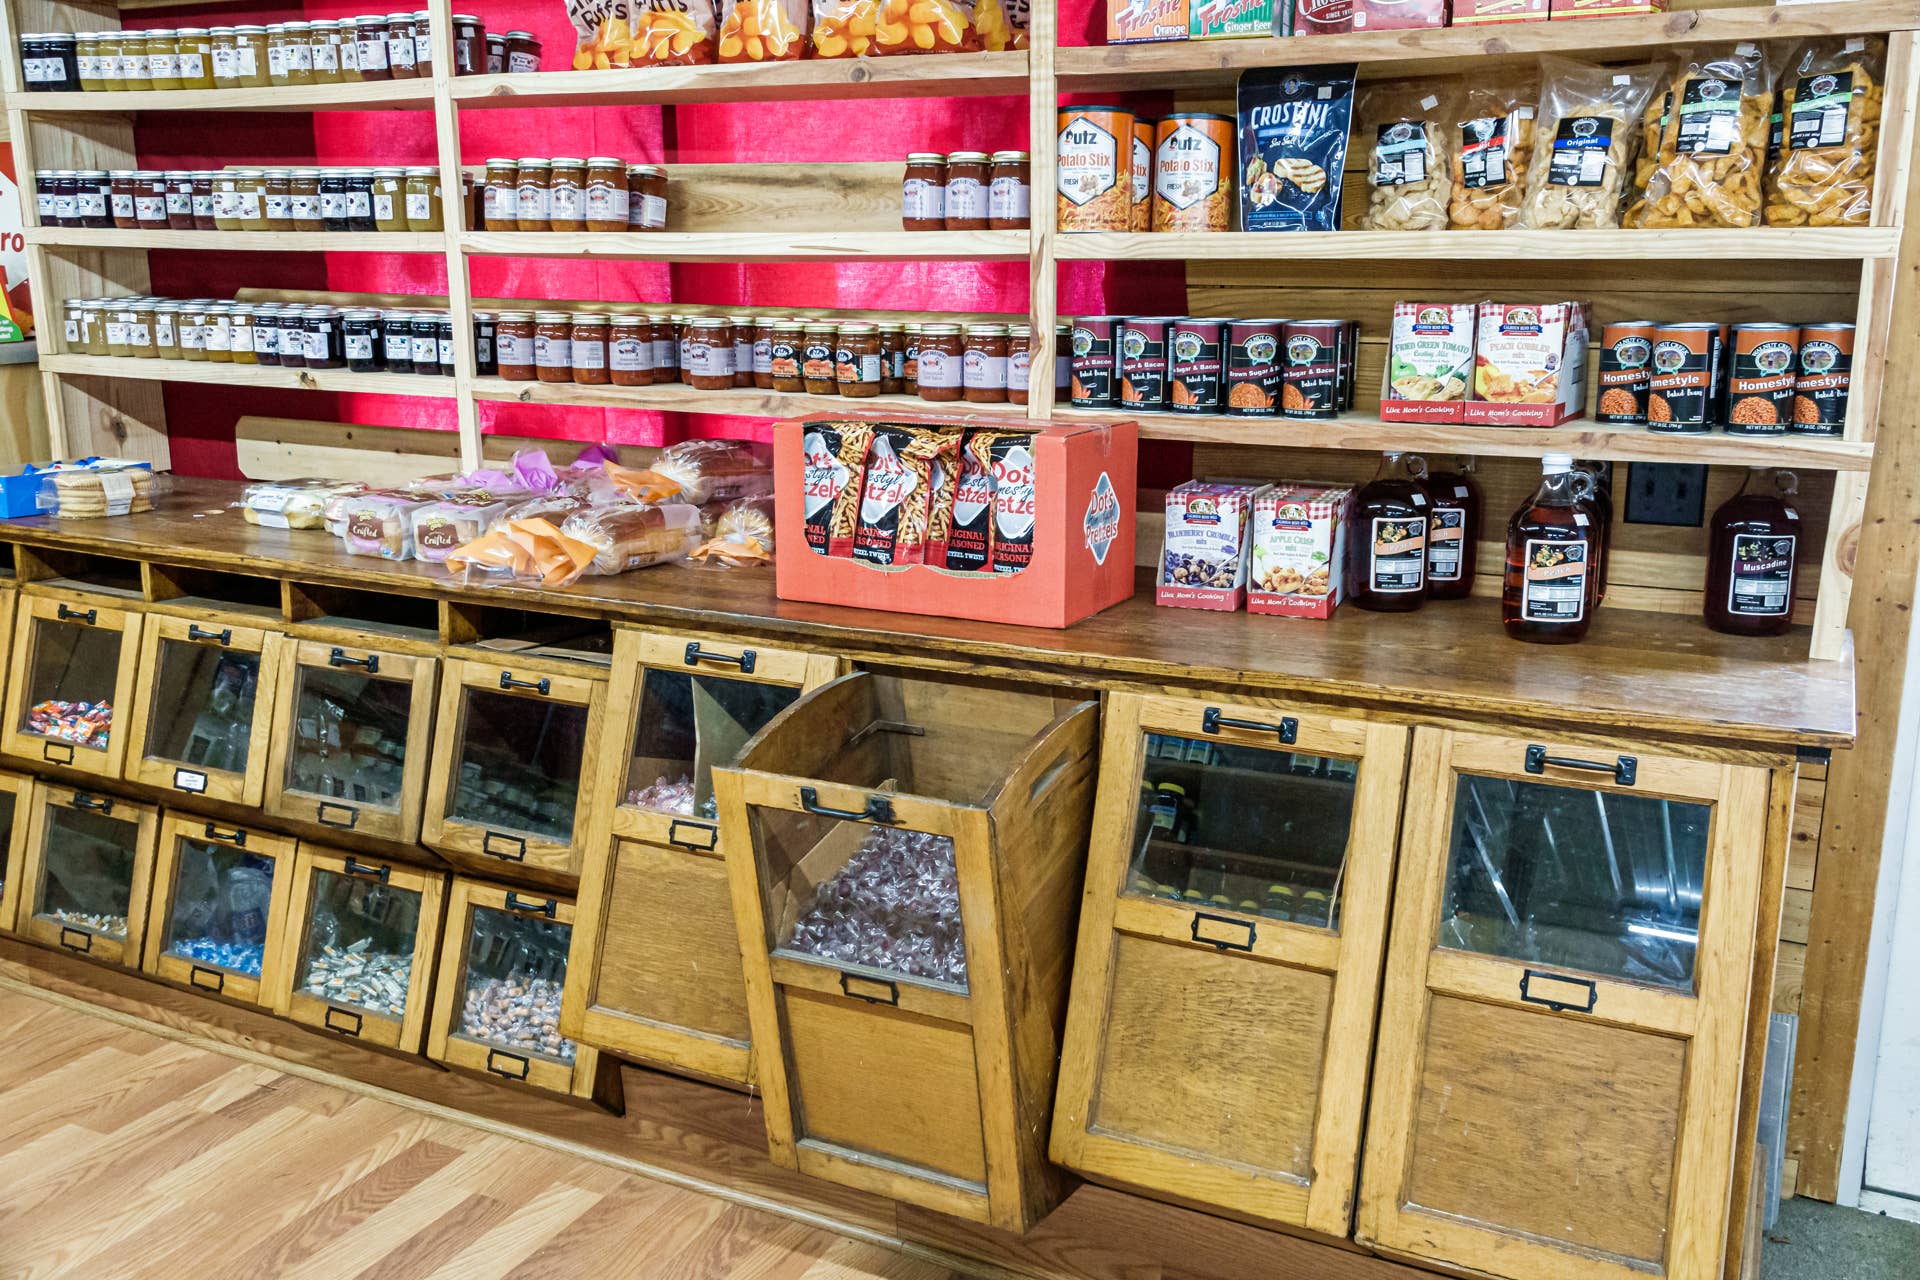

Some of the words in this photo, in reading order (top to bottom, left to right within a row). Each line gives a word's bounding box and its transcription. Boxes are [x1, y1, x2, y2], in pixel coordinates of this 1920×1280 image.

[1153, 24, 1187, 36] Orange
[1224, 22, 1251, 33] Ginger
[1254, 20, 1273, 31] Beer
[1251, 100, 1330, 130] CROSTINI
[1074, 131, 1098, 145] utz
[1178, 136, 1202, 151] utz
[1566, 138, 1599, 147] Original
[1089, 153, 1111, 166] Stix
[1160, 160, 1190, 173] Potato
[1192, 159, 1213, 172] Stix
[1395, 342, 1416, 352] FRIED
[1417, 341, 1440, 349] GREEN
[1442, 341, 1470, 354] TOMATO
[1489, 342, 1515, 351] PEACH
[1516, 341, 1551, 353] COBBLER
[1248, 368, 1269, 376] Sugar
[1604, 370, 1651, 382] Homesty
[1650, 374, 1700, 387] omestyle
[1797, 375, 1849, 388] omestyle
[1402, 406, 1423, 414] Mom's
[1425, 406, 1455, 415] Cooking
[1488, 409, 1510, 417] Mom's
[1512, 408, 1544, 418] Cooking
[1090, 488, 1114, 515] Dot's
[353, 525, 377, 538] Crafted
[1085, 521, 1117, 548] Pretzels
[1168, 529, 1204, 539] BLUEBERRY
[1206, 530, 1237, 543] CRUMBLE
[424, 535, 452, 546] Crafted
[1269, 535, 1293, 544] APPLE
[964, 552, 985, 561] TWISTS
[1743, 559, 1787, 571] Muscadine
[1197, 592, 1225, 602] Cooking
[1288, 599, 1316, 608] Cooking
